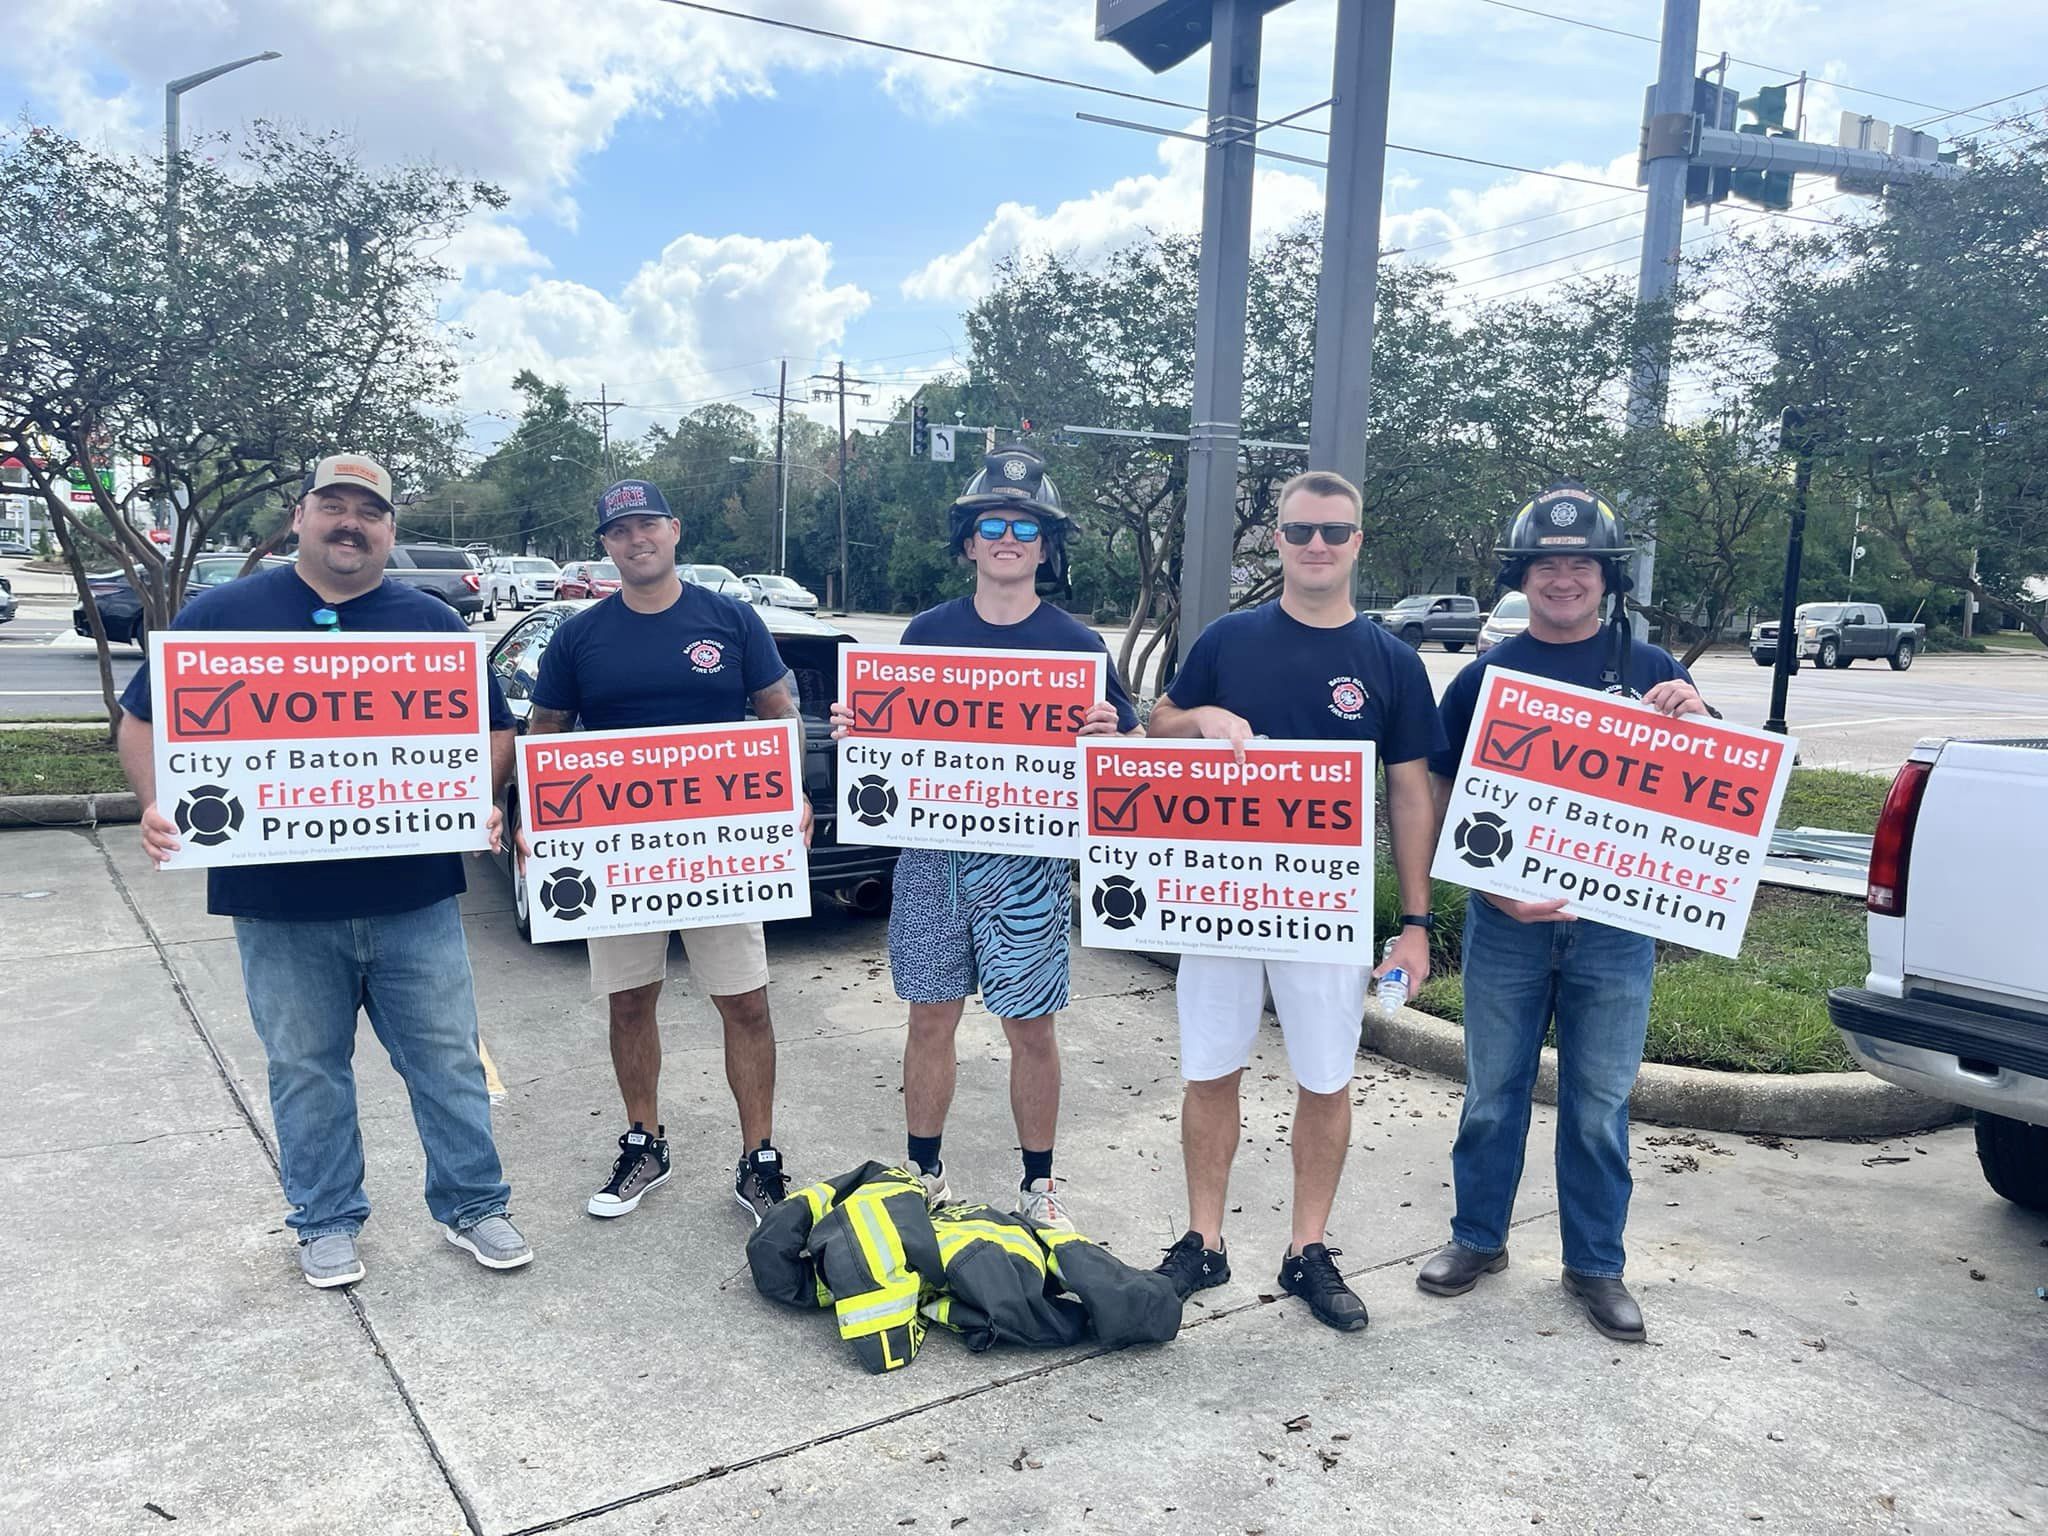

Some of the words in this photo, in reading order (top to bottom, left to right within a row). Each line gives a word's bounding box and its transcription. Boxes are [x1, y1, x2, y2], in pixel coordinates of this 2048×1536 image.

[178, 651, 284, 674] Please
[294, 652, 416, 679] support
[425, 651, 465, 672] us!
[857, 660, 935, 682] Please
[943, 668, 1042, 690] support
[1050, 668, 1085, 688] us!
[250, 691, 373, 723] VOTE
[392, 689, 468, 720] YES
[907, 698, 1003, 729] VOTE
[1020, 703, 1085, 732] YES
[1499, 687, 1592, 728] Please
[1598, 717, 1717, 758] support
[1724, 746, 1769, 770] us!
[170, 753, 231, 777] City
[246, 750, 276, 770] of
[290, 751, 377, 769] Baton
[392, 747, 478, 768] Rouge
[537, 750, 624, 771] Please
[632, 740, 736, 768] support
[744, 735, 779, 756] us!
[846, 746, 891, 769] City
[902, 749, 925, 766] of
[935, 751, 1004, 770] Baton
[1016, 755, 1076, 780] Roug
[1097, 755, 1182, 777] Please
[1191, 758, 1302, 785] support
[1311, 761, 1350, 782] us!
[259, 776, 475, 809] Firefighters’
[597, 777, 701, 810] VOTE
[716, 771, 783, 801] YES
[909, 778, 1078, 807] Firefighters
[1552, 740, 1663, 794] VOTE
[1683, 772, 1758, 816] YES
[263, 808, 475, 844] Proposition
[911, 807, 1079, 837] Proposition
[1153, 795, 1260, 827] VOTE
[1277, 798, 1352, 830] YES
[1466, 777, 1518, 809] City
[1529, 797, 1558, 814] of
[1566, 802, 1648, 839] Baton
[1661, 826, 1749, 865] Rouge
[534, 839, 584, 860] City
[596, 834, 620, 853] of
[632, 832, 706, 850] Baton
[718, 825, 793, 844] Rouge
[607, 849, 793, 884] Firefighters’
[1089, 845, 1137, 870] City
[1149, 848, 1174, 866] of
[1185, 850, 1261, 871] Baton
[1276, 854, 1359, 880] Rouge
[1529, 826, 1741, 895] Firefighters’
[612, 881, 792, 916] Proposition
[1157, 878, 1357, 911] Firefighters’
[1522, 857, 1725, 930] Proposition
[1161, 910, 1353, 942] Proposition
